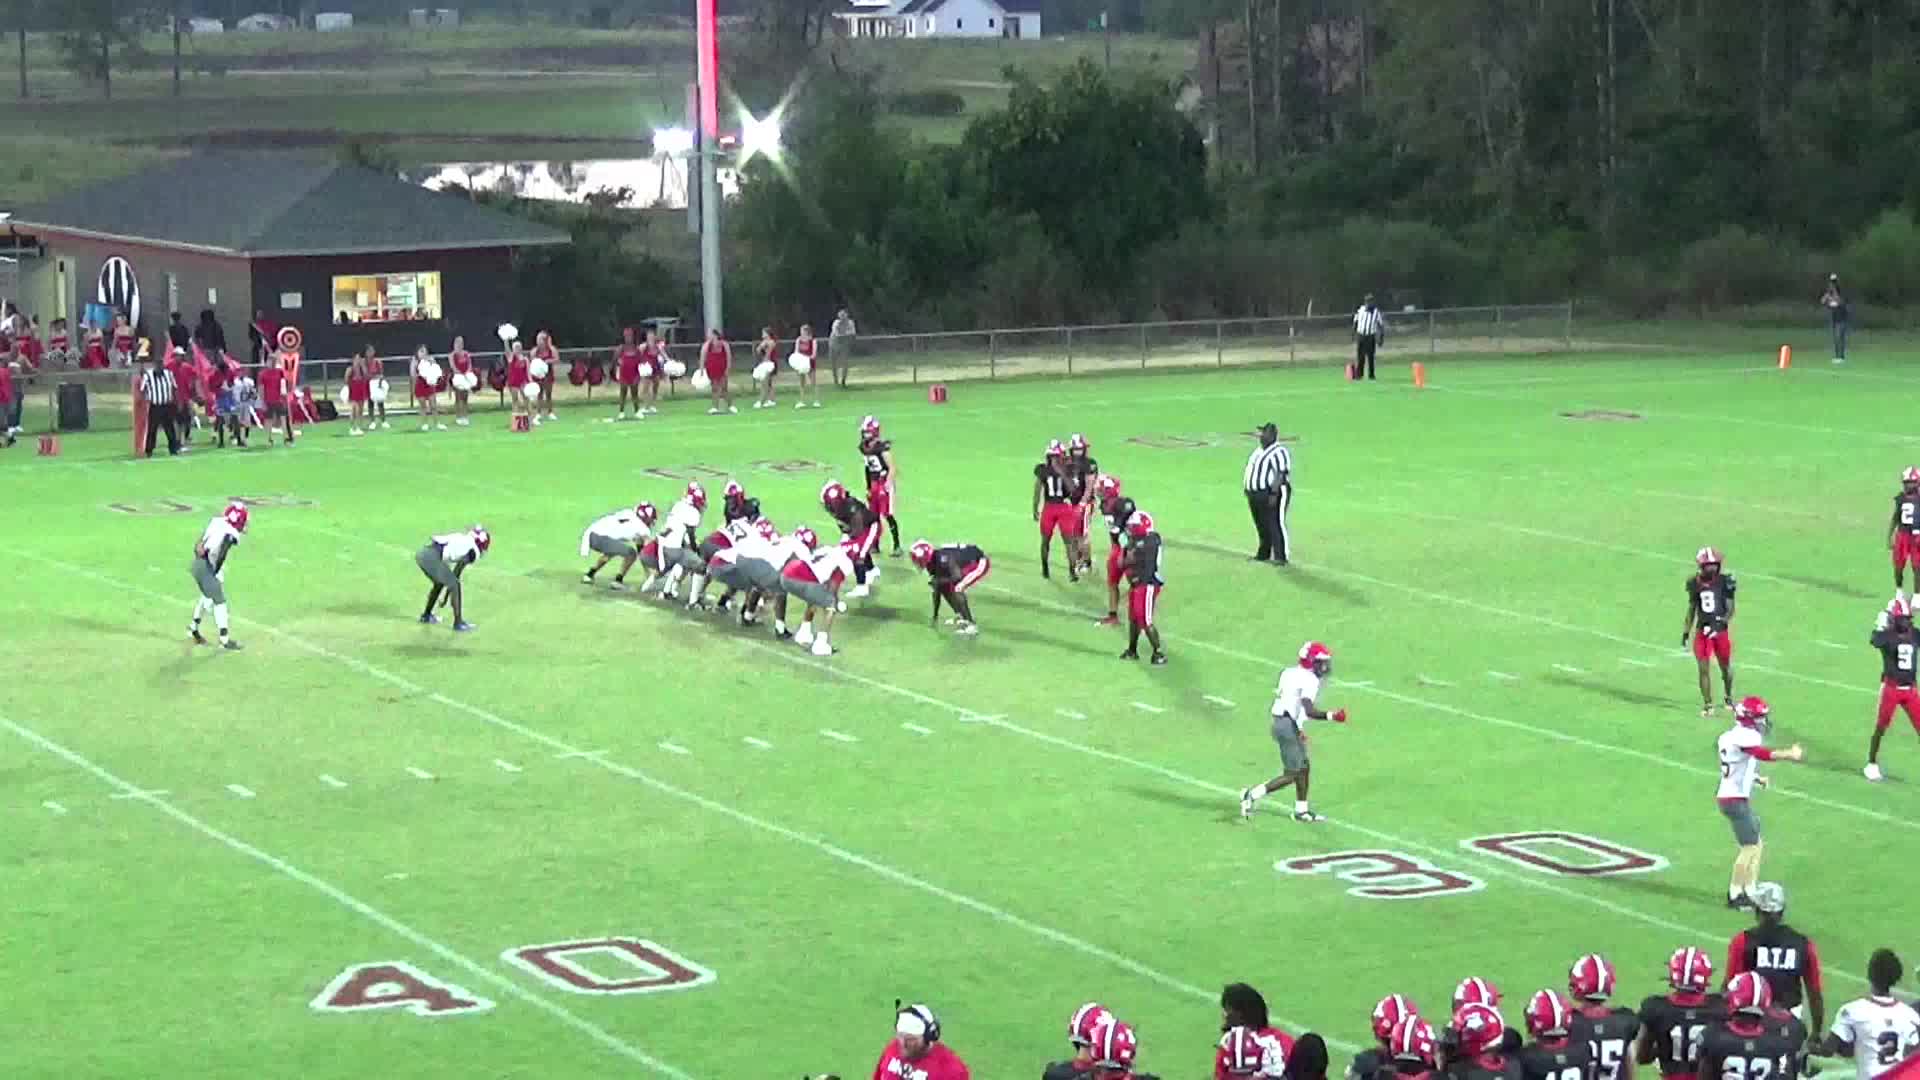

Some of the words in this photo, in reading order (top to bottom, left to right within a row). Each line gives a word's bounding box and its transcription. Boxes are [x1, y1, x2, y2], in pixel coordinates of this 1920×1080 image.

[1047, 475, 1063, 497] 11
[1901, 502, 1915, 524] 2
[1700, 591, 1715, 612] 8
[1897, 644, 1914, 670] 9
[1877, 1030, 1899, 1066] 2
